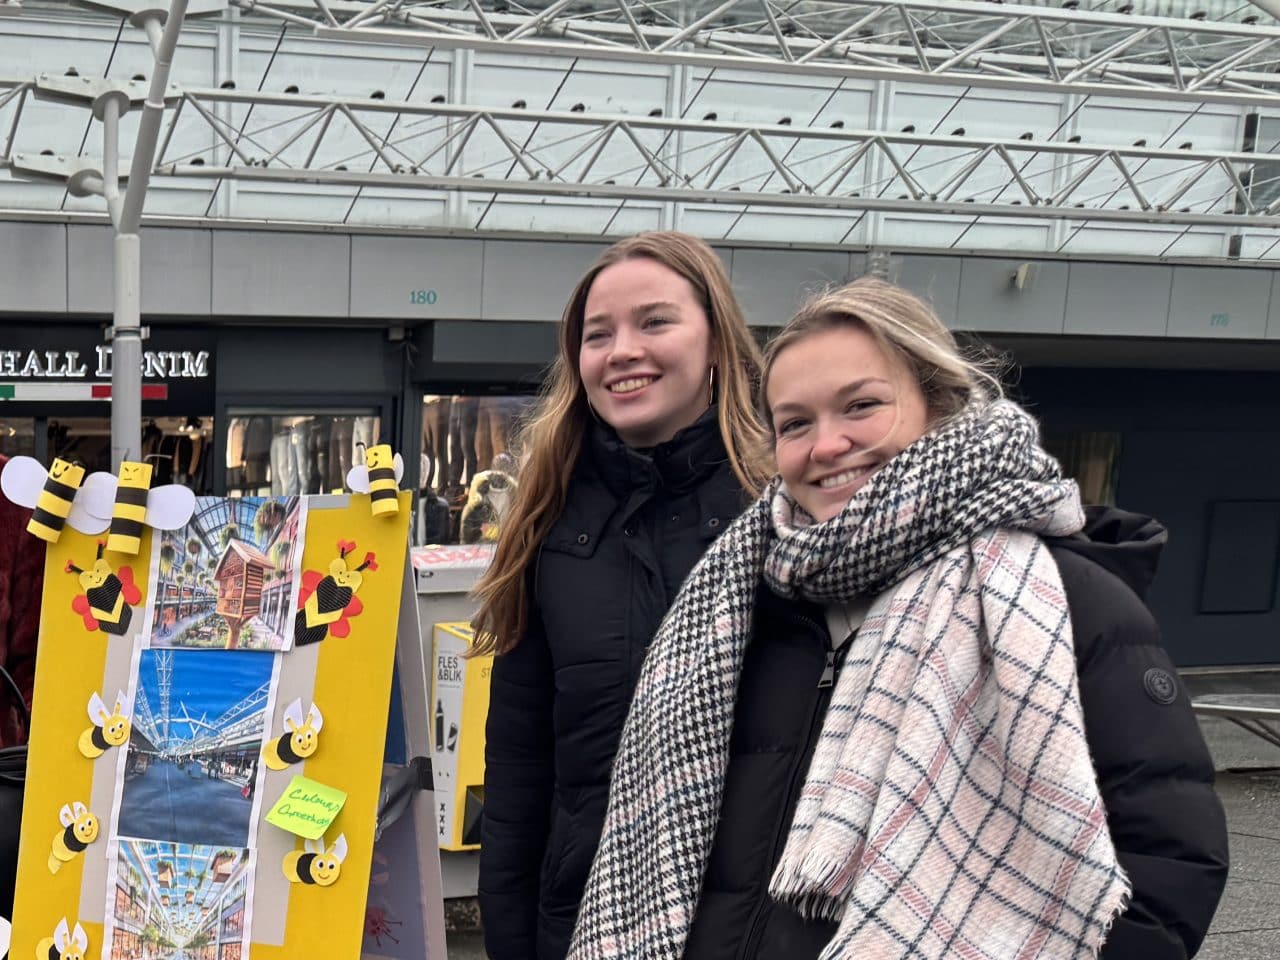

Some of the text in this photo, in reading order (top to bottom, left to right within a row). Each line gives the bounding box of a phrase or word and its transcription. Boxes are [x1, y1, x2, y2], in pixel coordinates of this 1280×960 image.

[410, 288, 438, 305] 180
[95, 345, 210, 378] DNIM
[438, 655, 459, 669] FLES
[438, 668, 462, 682] &BLIK
